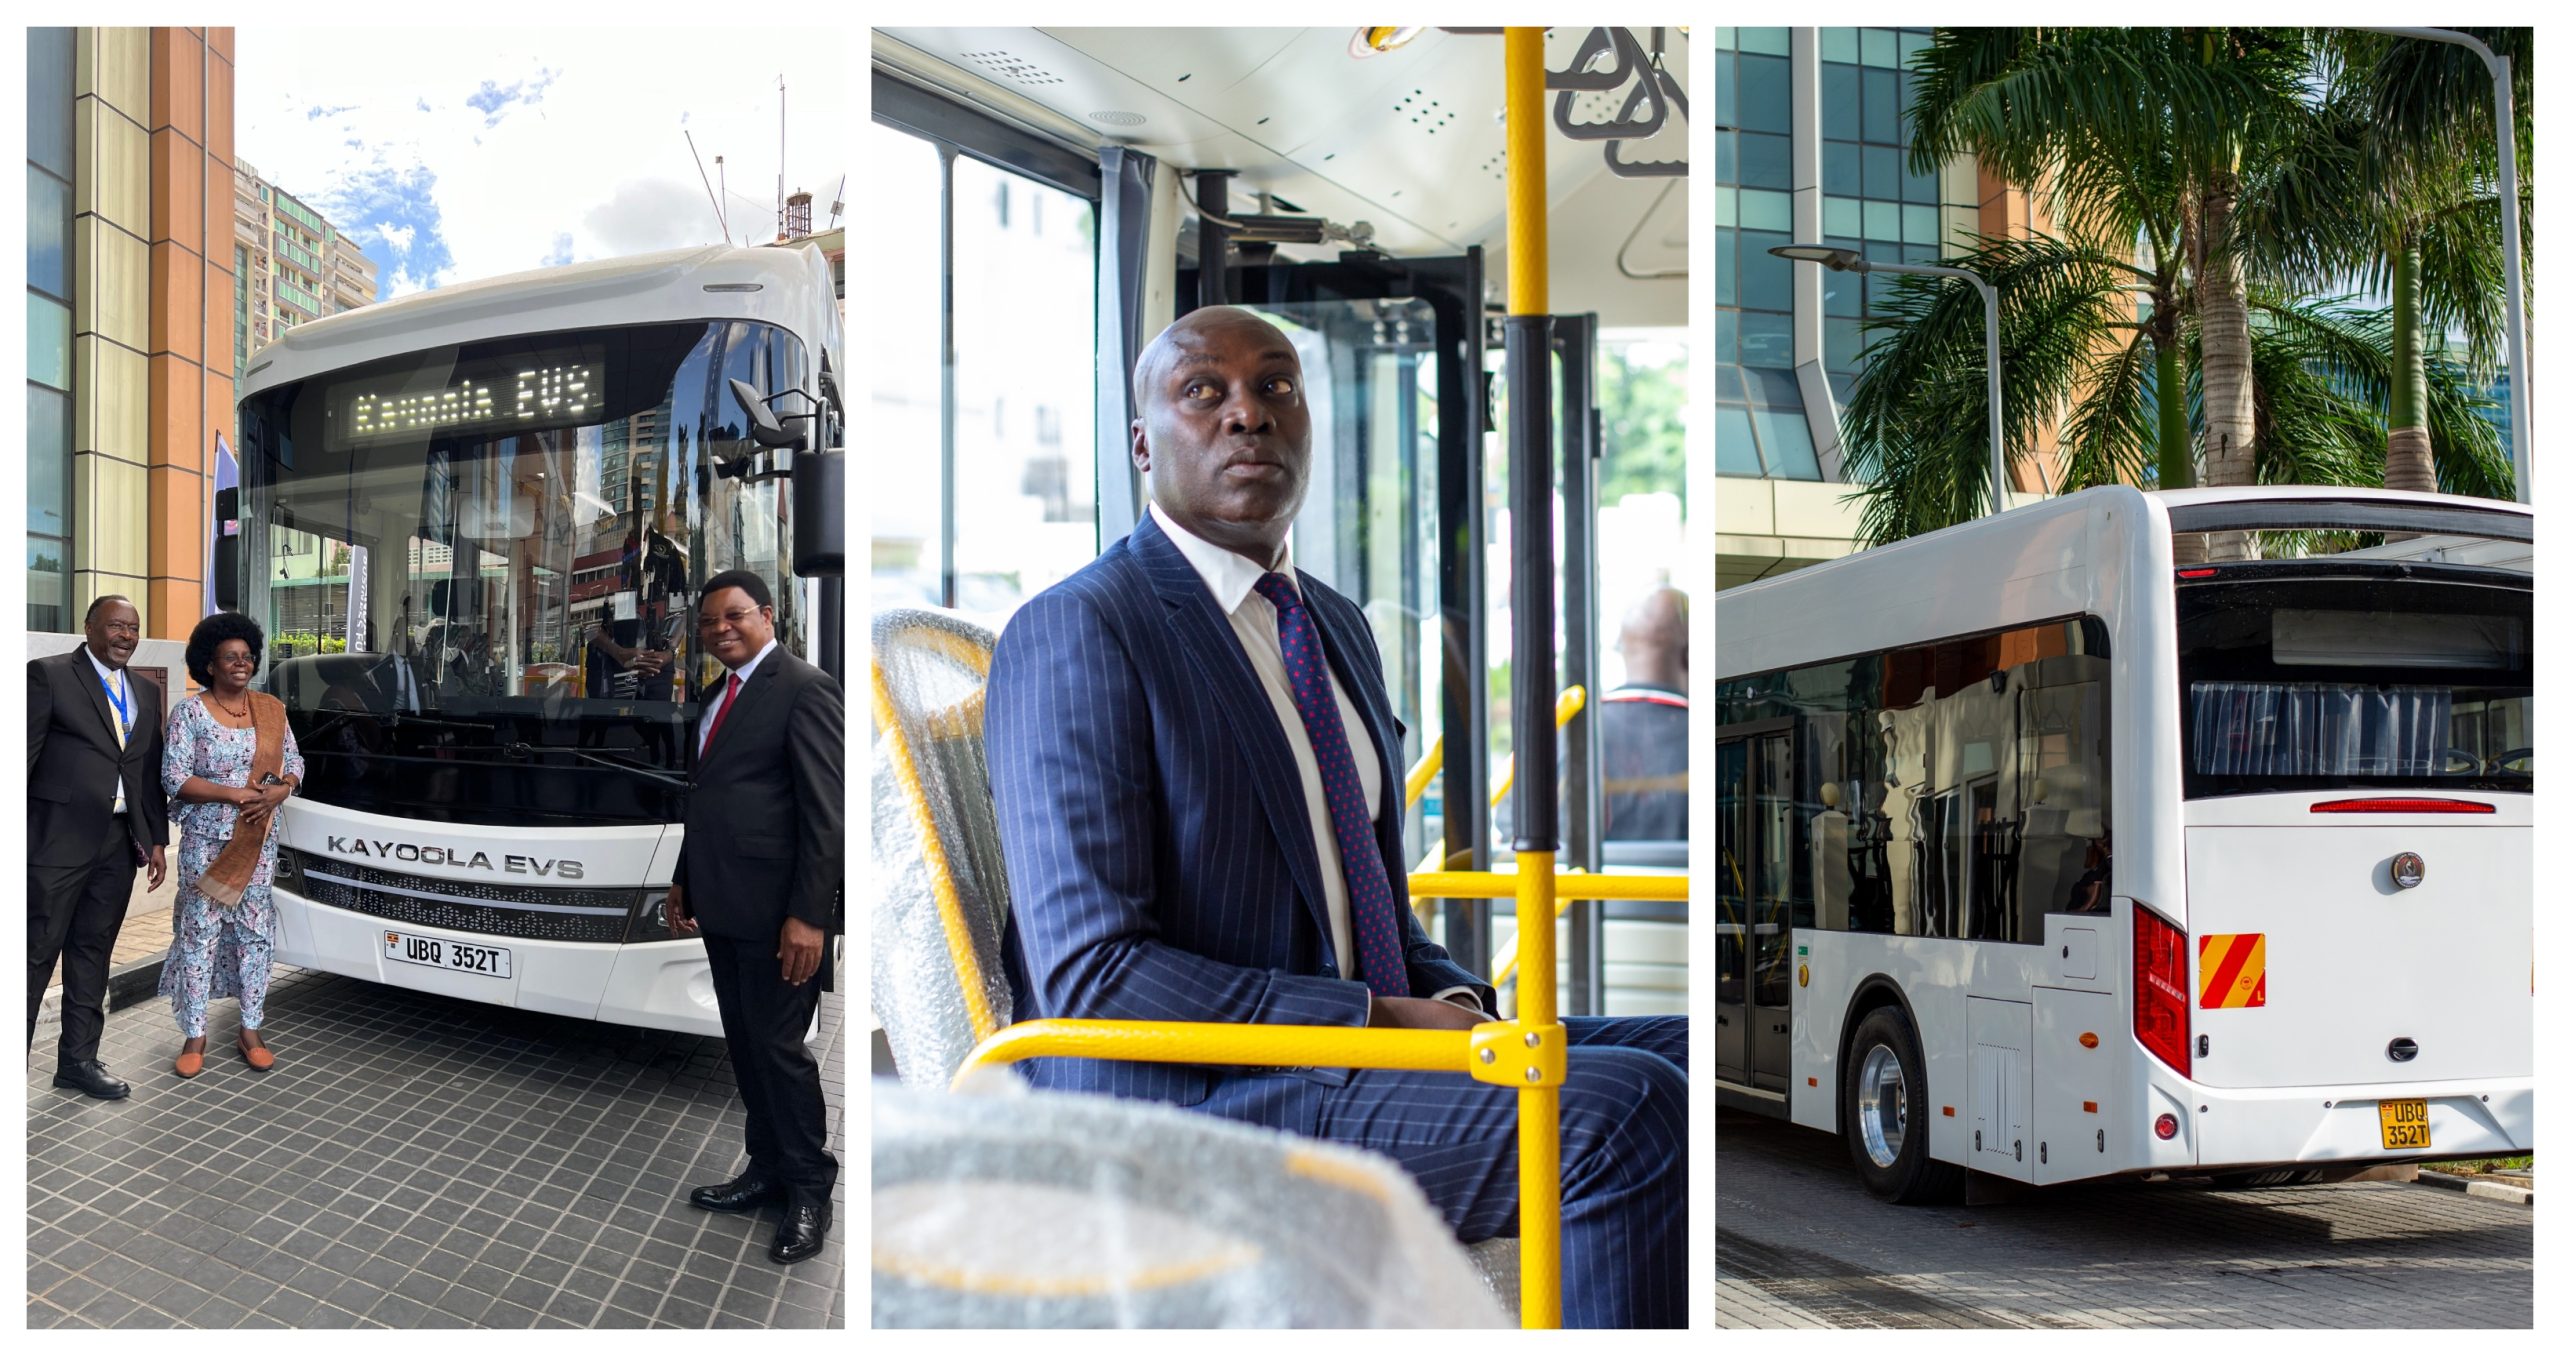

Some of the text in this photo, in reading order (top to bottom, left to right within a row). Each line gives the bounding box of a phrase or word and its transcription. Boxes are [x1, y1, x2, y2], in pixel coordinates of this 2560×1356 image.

[517, 365, 590, 417] EVS
[328, 835, 585, 879] KAYOOLA EVS
[406, 937, 500, 973] UBQ 352T
[2257, 990, 2265, 1001] L
[2394, 1102, 2426, 1123] UBQ
[2387, 1124, 2427, 1146] 352T
